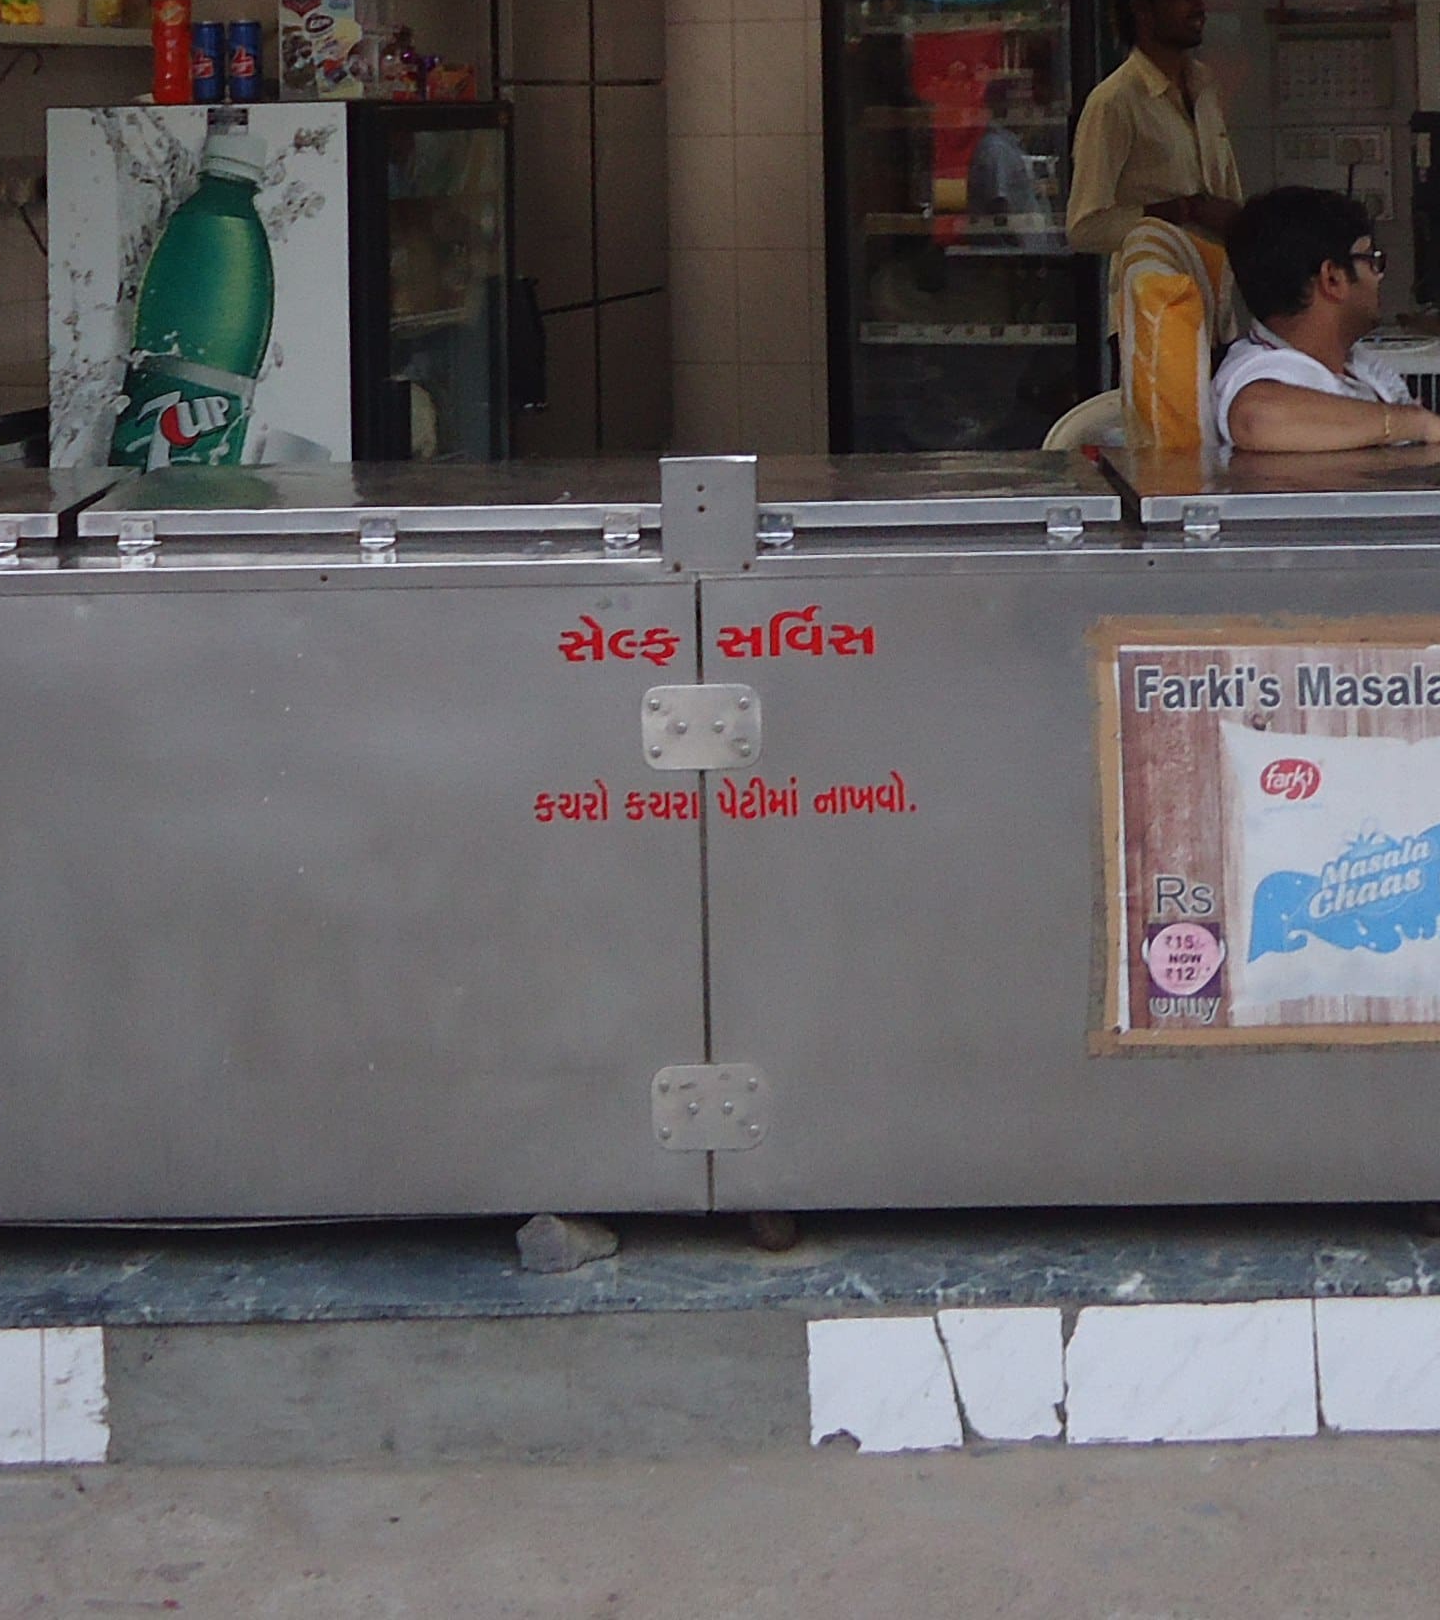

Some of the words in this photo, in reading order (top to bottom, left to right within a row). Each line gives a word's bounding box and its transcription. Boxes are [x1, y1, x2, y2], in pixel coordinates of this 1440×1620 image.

[558, 614, 681, 667] સેલ્ફ
[716, 605, 876, 657] સર્વિસ
[1136, 666, 1281, 711] Farki's
[533, 779, 609, 823] કચરો
[623, 789, 700, 822] કચરા
[717, 776, 798, 820] પેટીમાં
[1319, 838, 1431, 888] Masala
[1155, 876, 1214, 916] Rs
[1309, 866, 1422, 919] Chaas
